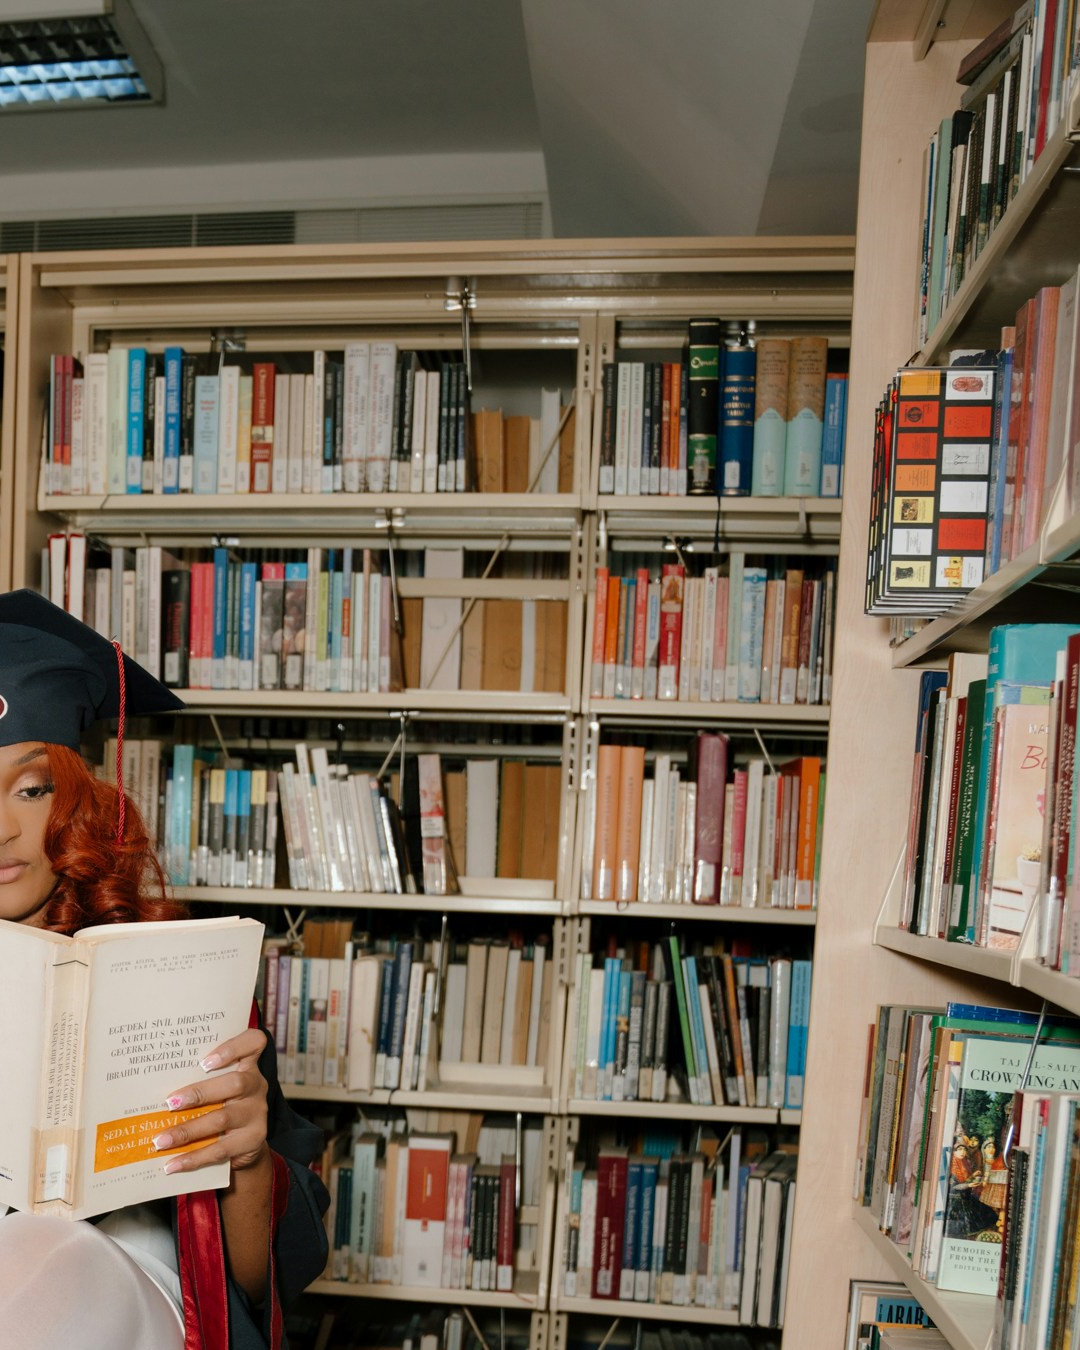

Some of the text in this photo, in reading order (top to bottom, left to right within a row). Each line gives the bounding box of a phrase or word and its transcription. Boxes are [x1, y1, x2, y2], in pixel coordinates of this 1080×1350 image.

[291, 568, 300, 579] 2
[963, 765, 975, 838] MAKALELER
[108, 1010, 226, 1036] EGE'DEKİ SİVİL DİRENİŞTEN
[121, 1025, 211, 1045] KURTULUŞ SAVAŞI'NA
[110, 1033, 219, 1058] GEÇERKEN UŞAK HEYET-İ
[128, 1048, 199, 1066] MERKEZİYESİ VE
[1000, 1057, 1021, 1068] TAJ
[106, 1059, 200, 1082] İBRAHİM (TAHTAKILIÇ)
[970, 1069, 1055, 1089] CROWNING
[103, 1117, 179, 1141] SEDAT SİMAVİ
[106, 1142, 137, 1155] SOSYAL
[949, 1254, 996, 1265] FROM THE
[950, 1244, 991, 1257] MEMOIRS
[953, 1264, 982, 1274] EDITED
